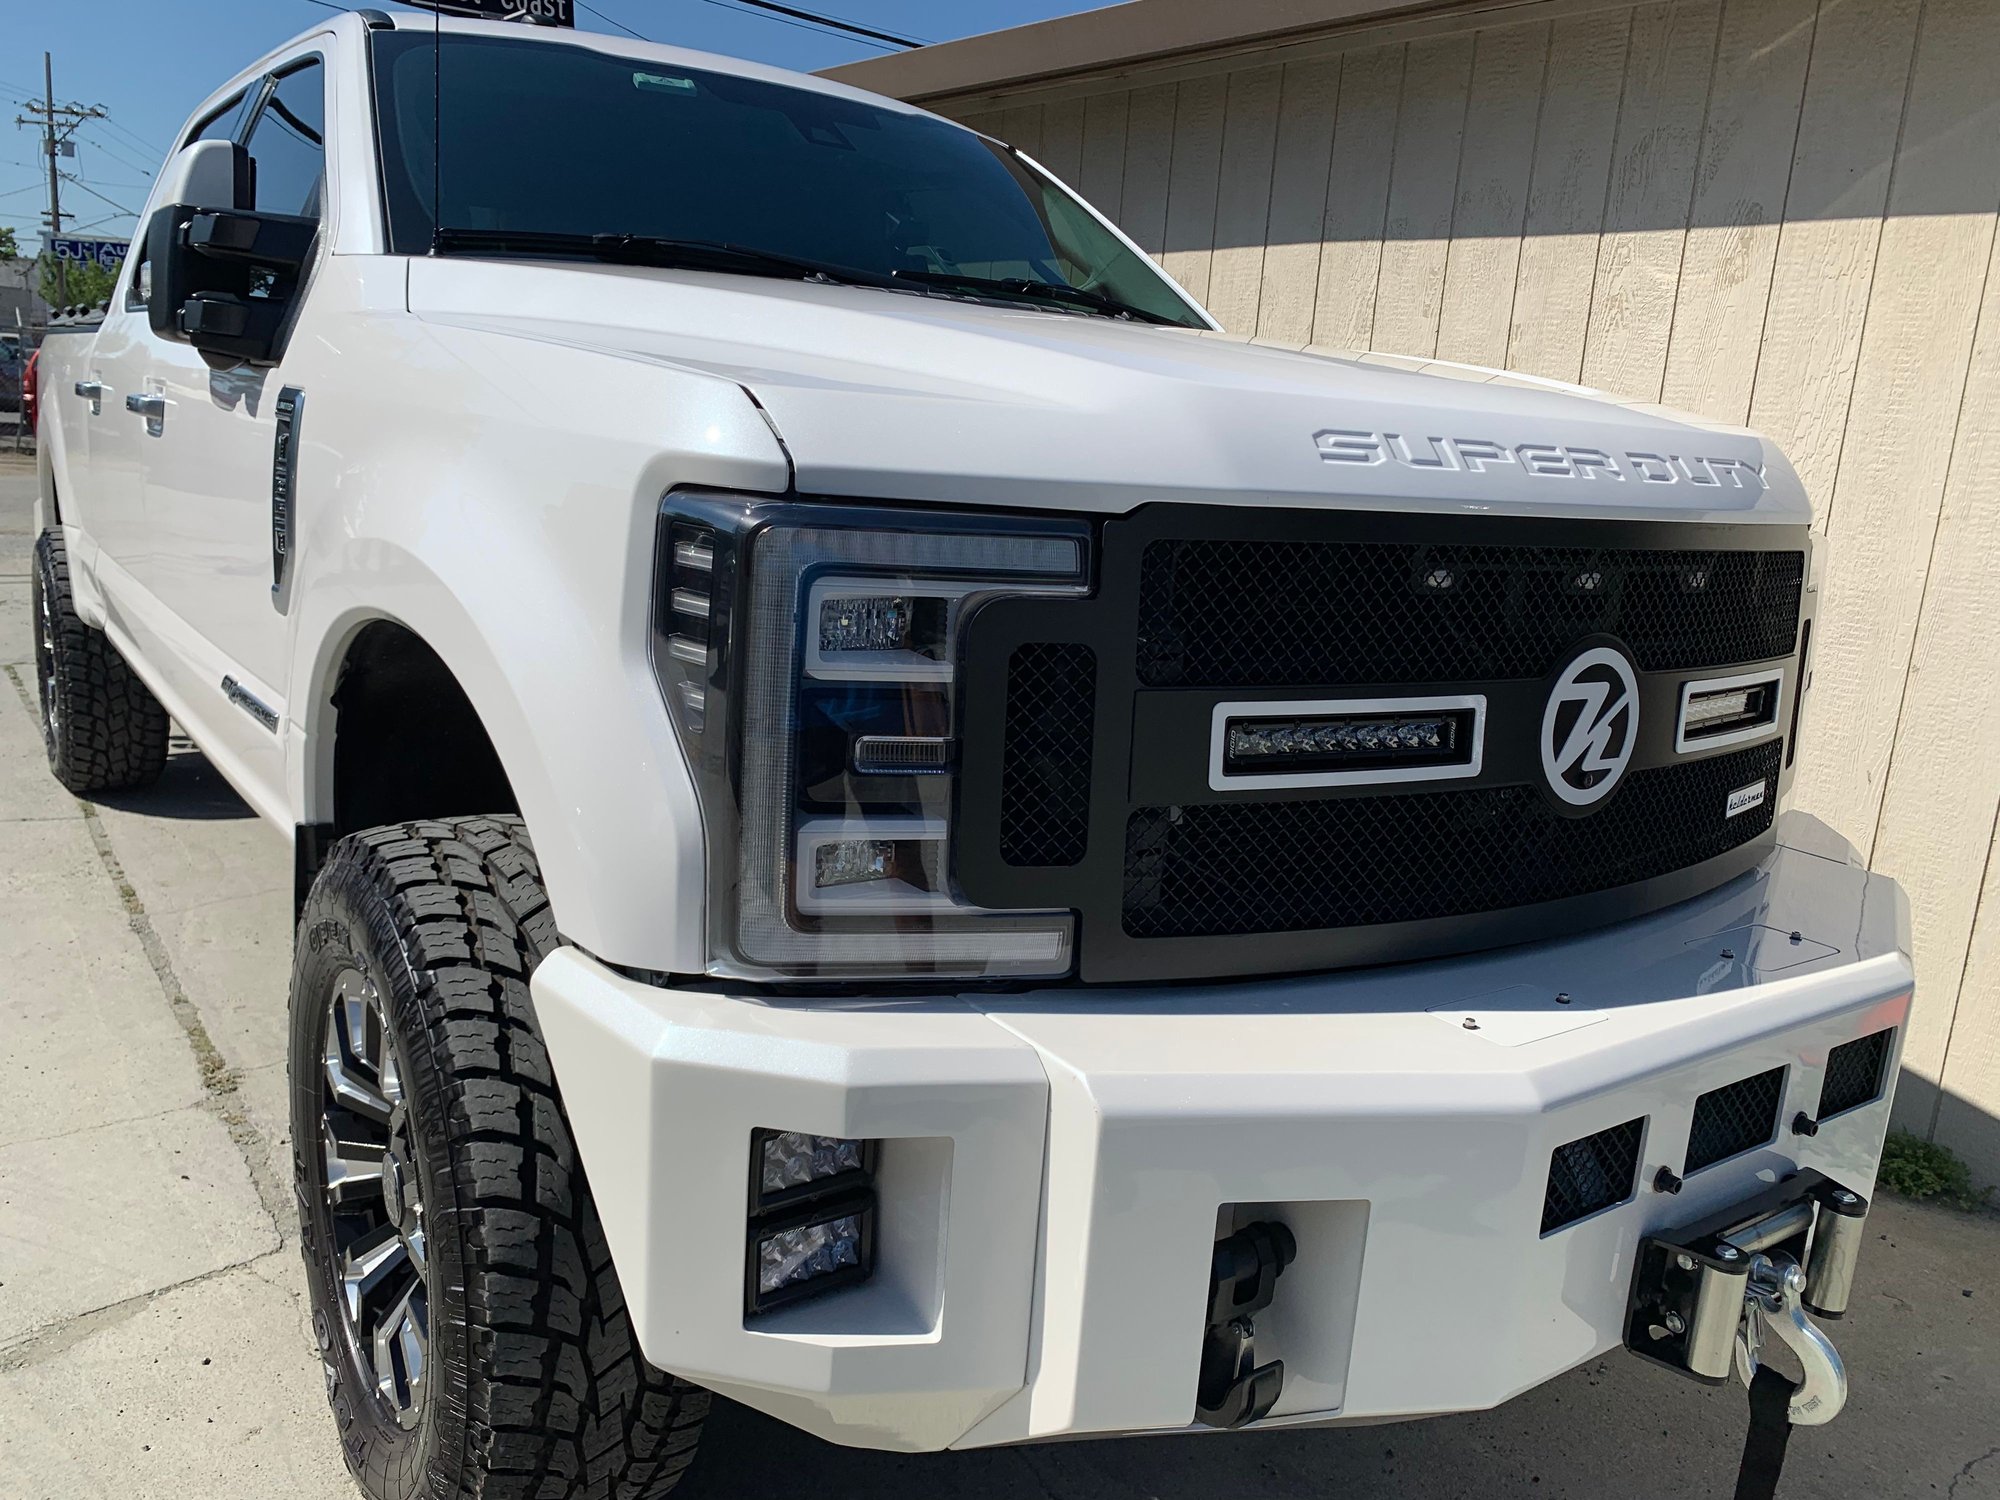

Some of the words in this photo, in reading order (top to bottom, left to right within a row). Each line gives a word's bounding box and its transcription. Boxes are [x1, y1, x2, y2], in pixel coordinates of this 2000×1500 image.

[1312, 428, 1625, 482] SUPER
[1624, 451, 1770, 489] DUTY
[773, 1226, 806, 1241] RIGID
